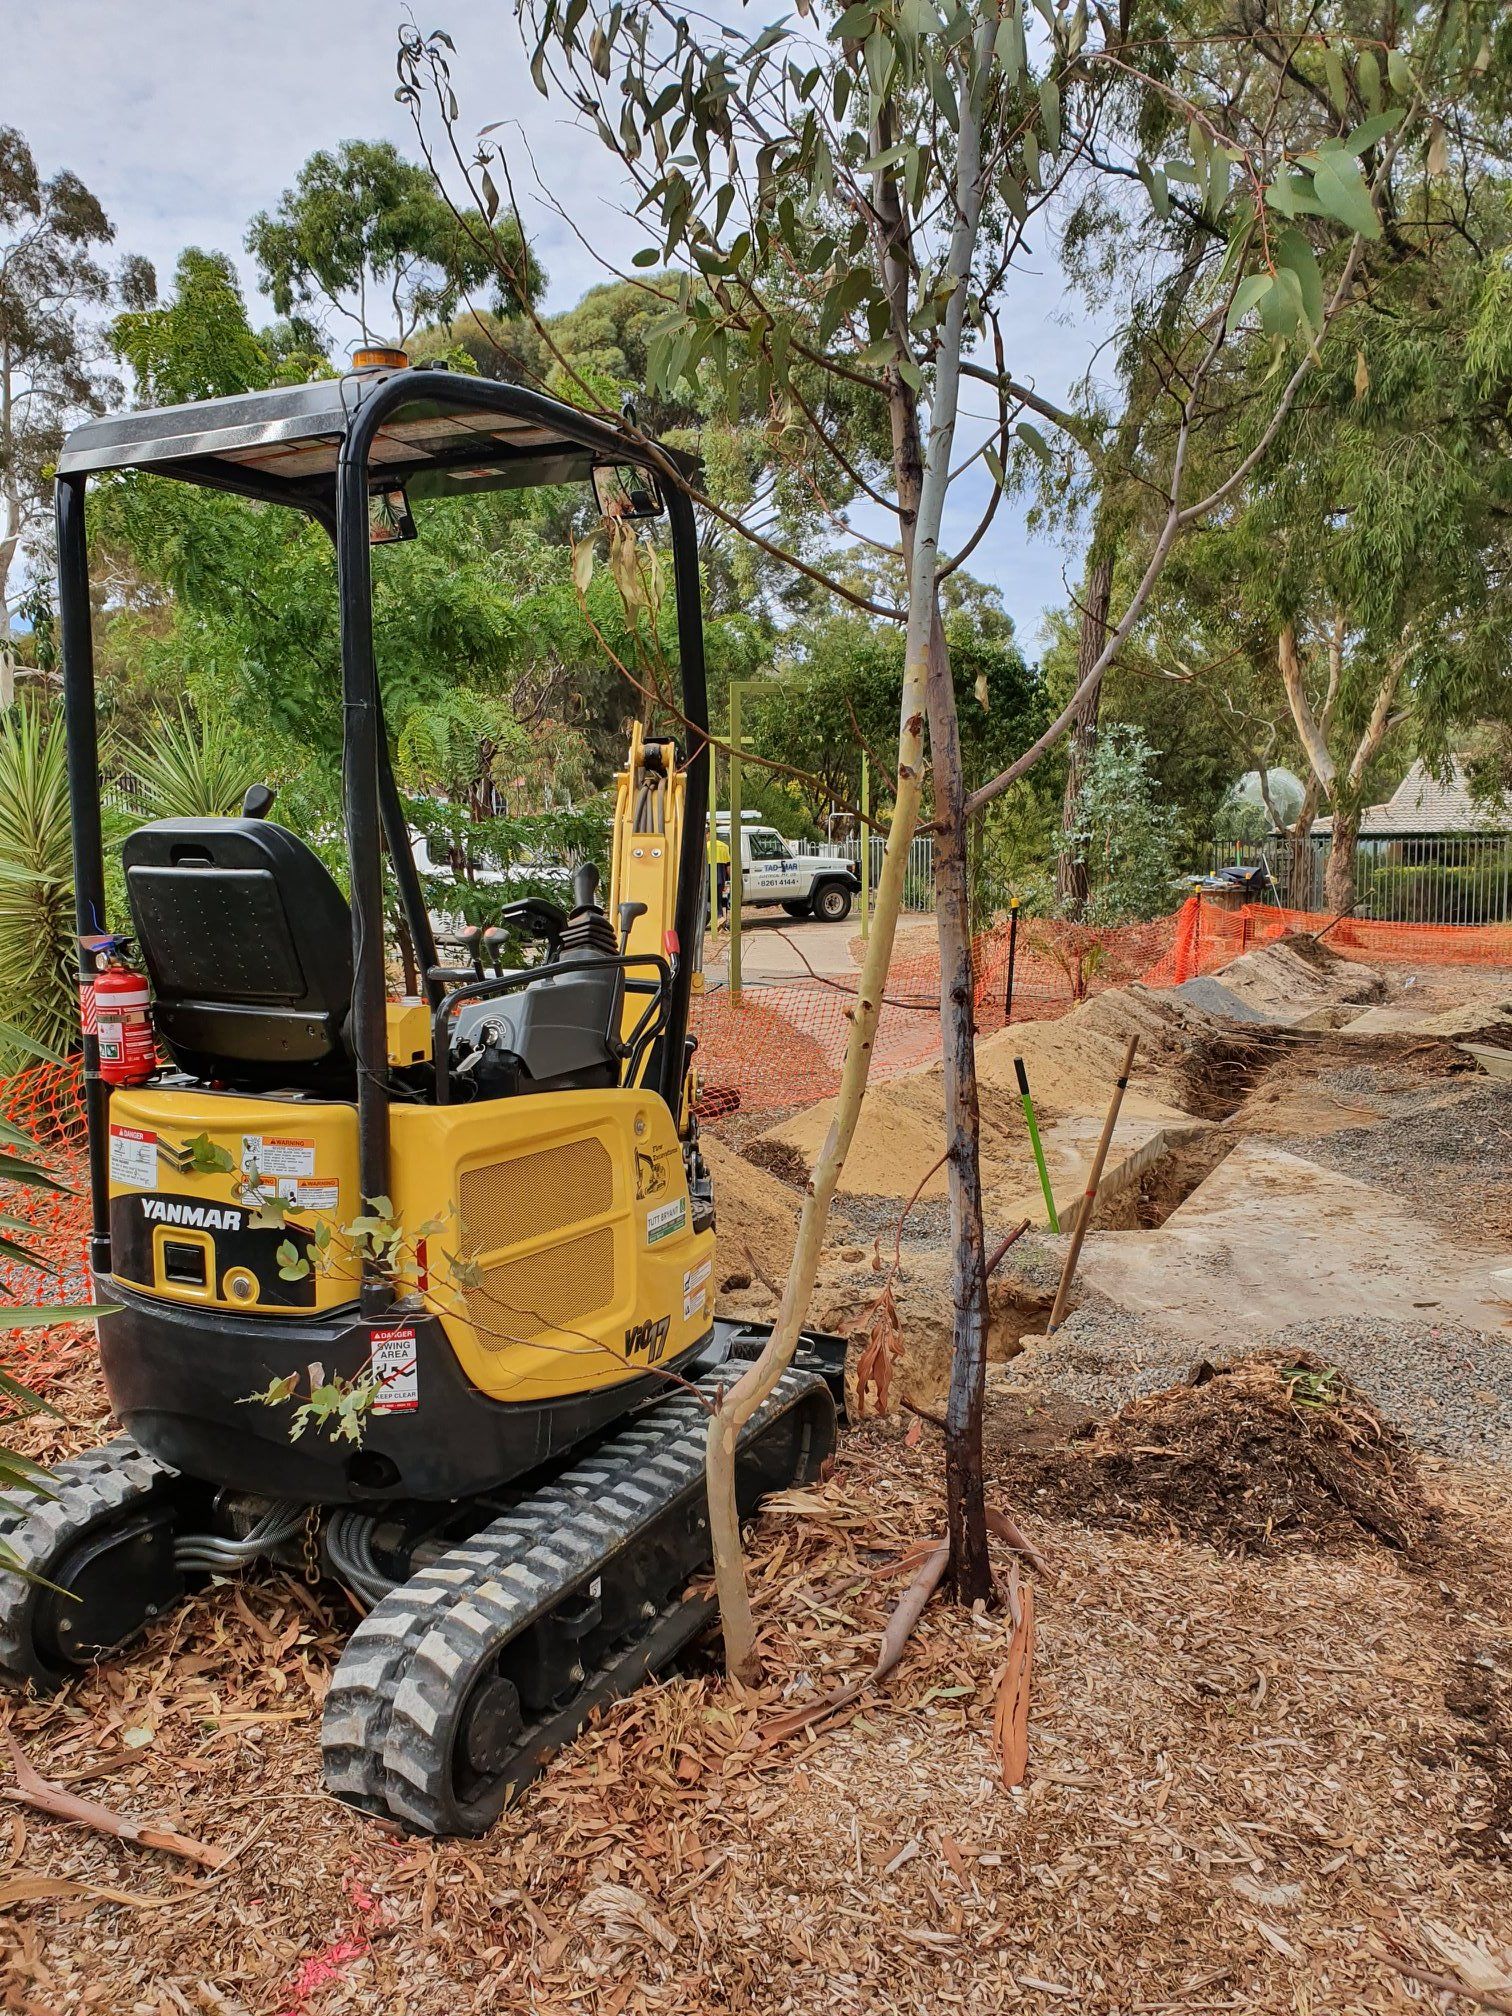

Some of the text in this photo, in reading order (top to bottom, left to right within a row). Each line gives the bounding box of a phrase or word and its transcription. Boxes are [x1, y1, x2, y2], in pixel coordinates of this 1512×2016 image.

[123, 1129, 144, 1140] DANGER
[276, 1139, 305, 1147] WARNING
[141, 1198, 241, 1231] YANMAR
[648, 1214, 661, 1227] TUTT
[377, 1341, 411, 1350] SWING
[381, 1350, 409, 1359] AREA
[394, 1391, 417, 1399] CLEAR
